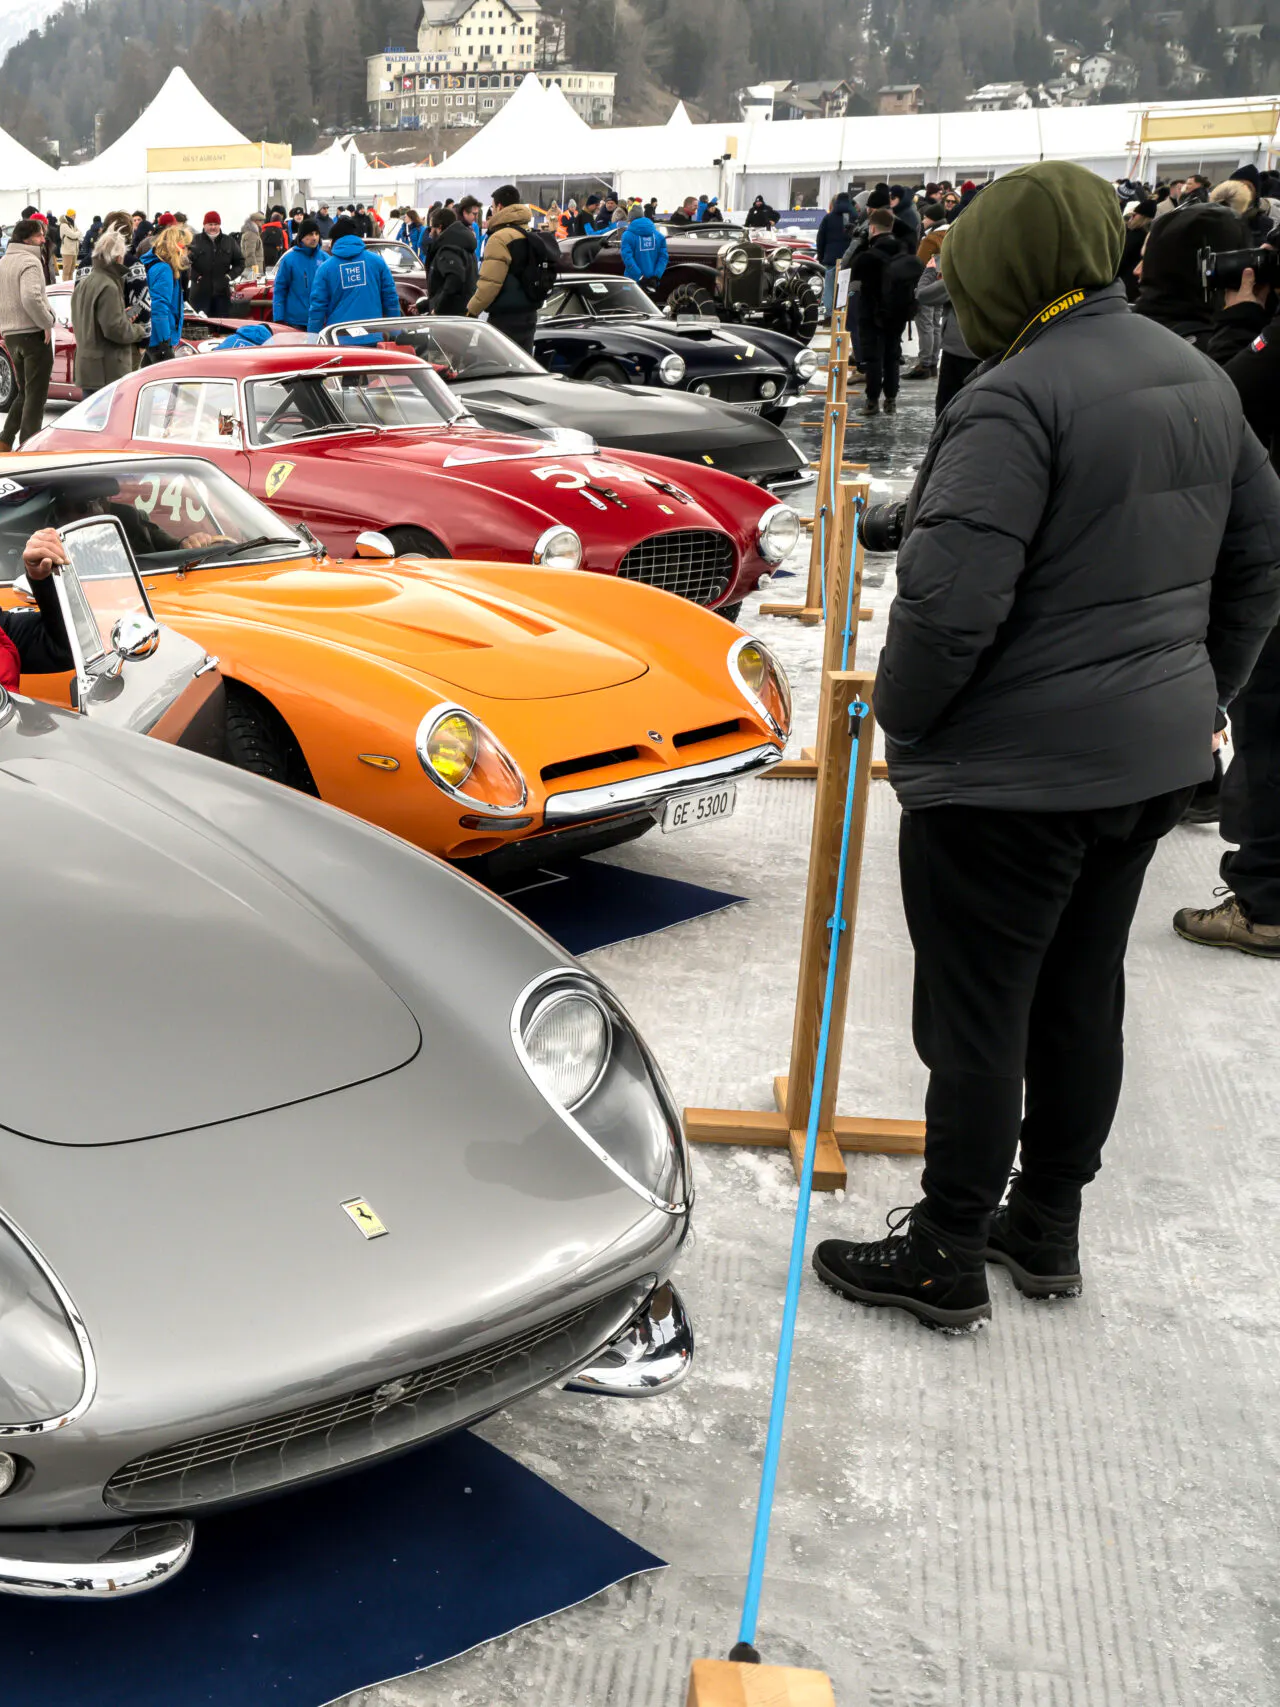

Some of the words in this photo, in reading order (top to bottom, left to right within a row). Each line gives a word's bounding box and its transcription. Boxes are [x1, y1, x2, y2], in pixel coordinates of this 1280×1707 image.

[182, 154, 227, 162] RESTAURANT
[345, 266, 361, 274] THE
[347, 274, 361, 282] ICE
[673, 801, 691, 826] GE
[696, 791, 728, 820] 5300
